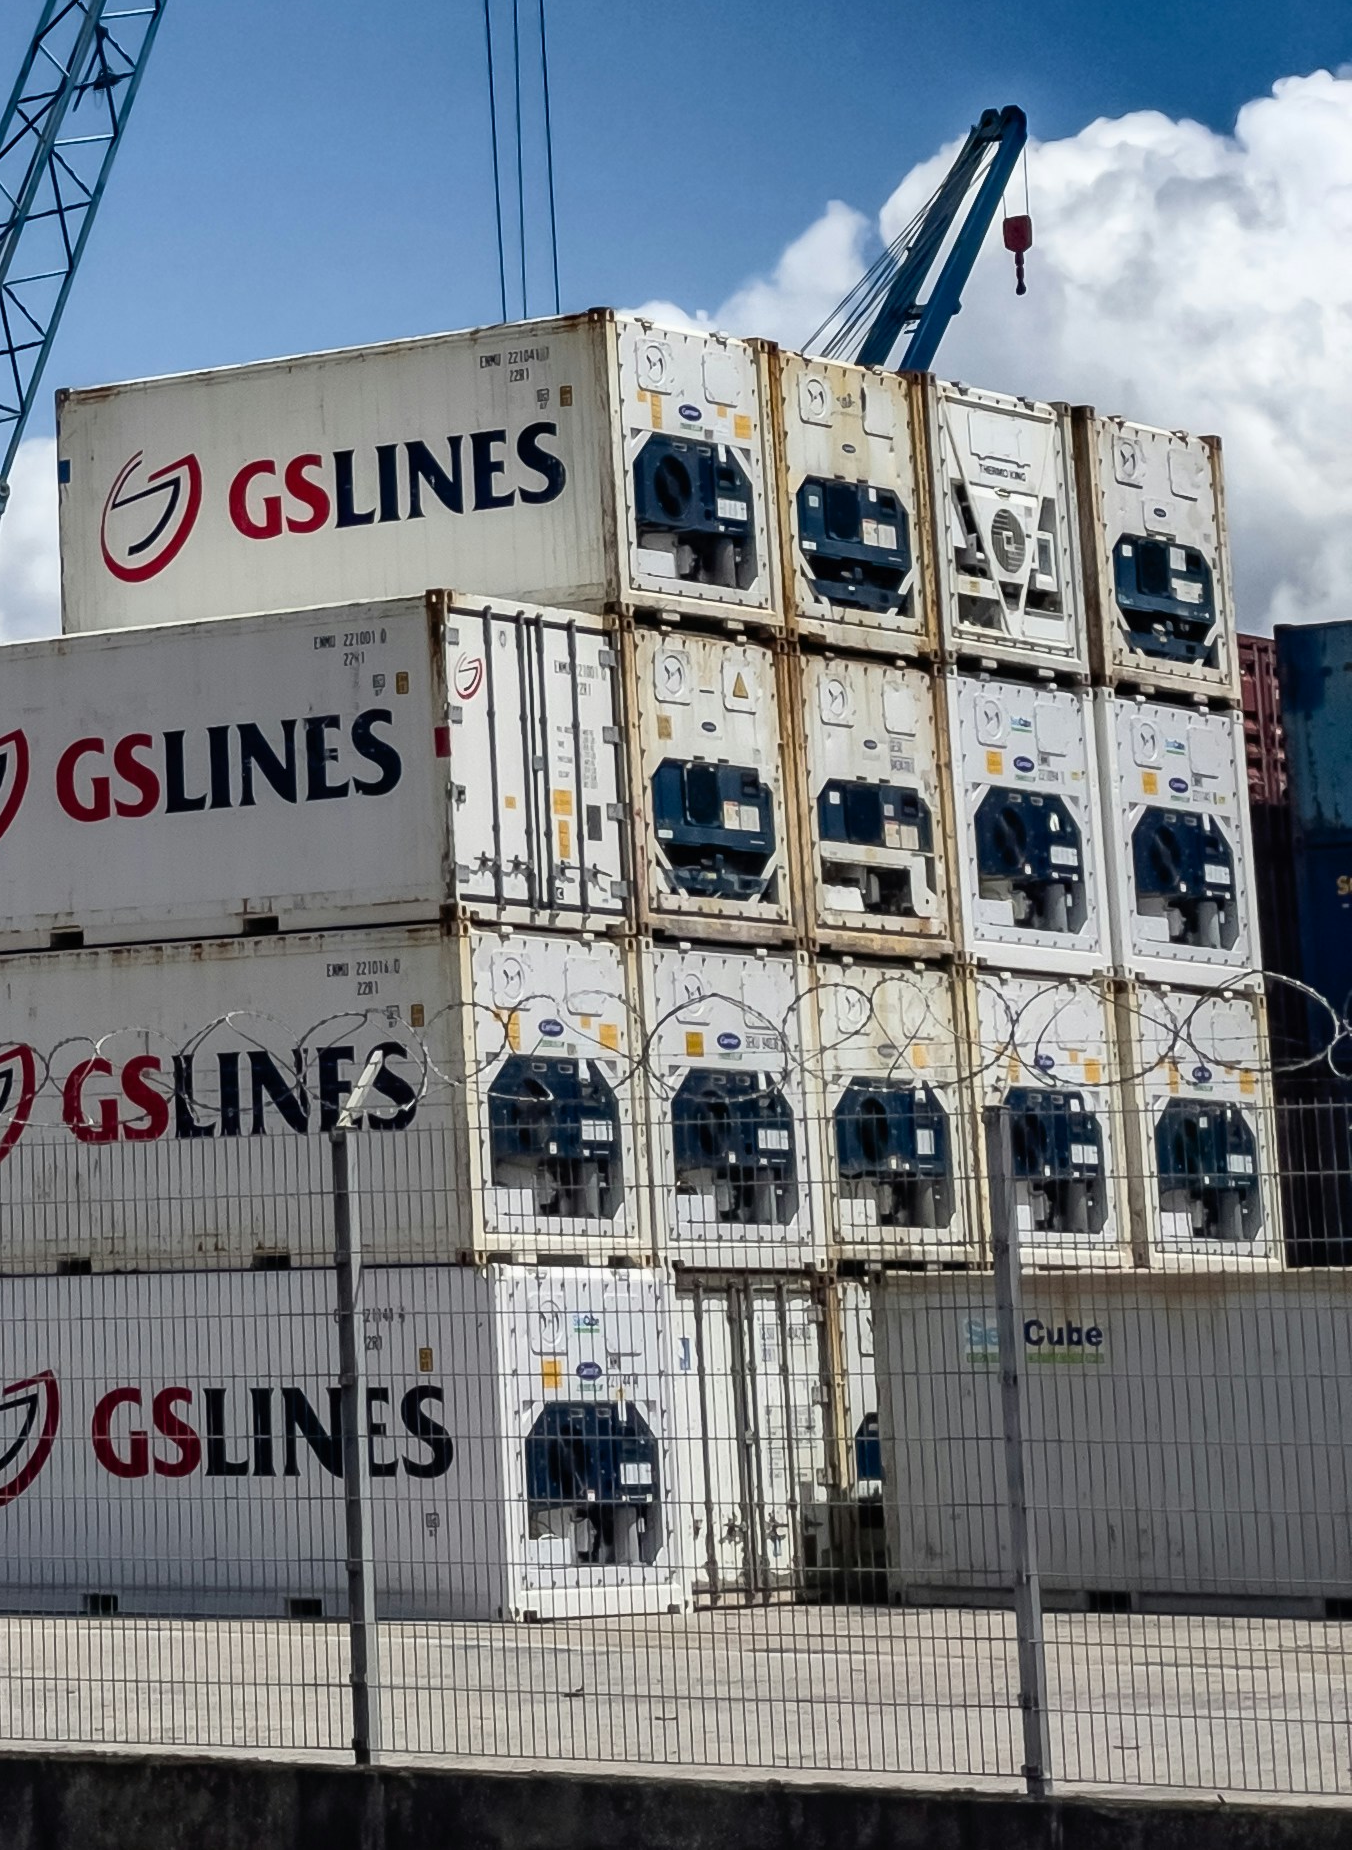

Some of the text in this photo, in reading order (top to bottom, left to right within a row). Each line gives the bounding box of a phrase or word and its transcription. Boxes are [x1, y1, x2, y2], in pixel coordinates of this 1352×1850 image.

[228, 420, 567, 540] GSLINES
[343, 630, 376, 647] 221001
[56, 708, 402, 823] GSLINES
[62, 1041, 418, 1144] GSLINES
[92, 1385, 454, 1479] GSLINES
